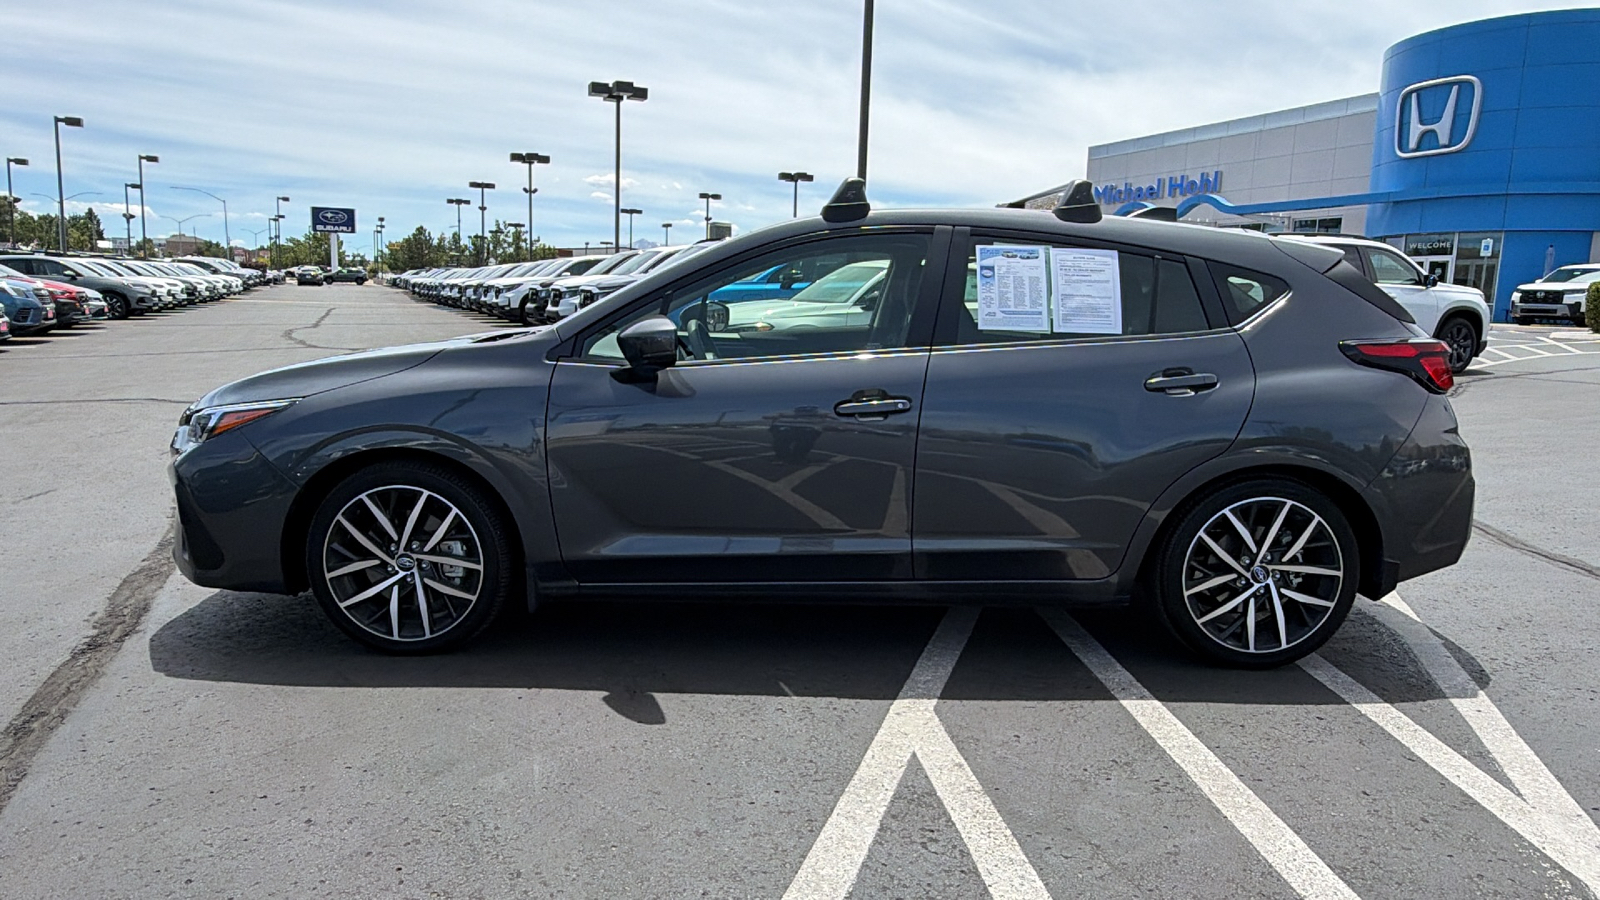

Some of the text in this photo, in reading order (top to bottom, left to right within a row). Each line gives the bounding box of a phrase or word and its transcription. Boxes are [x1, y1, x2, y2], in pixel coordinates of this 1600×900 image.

[1094, 171, 1223, 205] Michael Hohl
[1409, 241, 1452, 249] WELCOME
